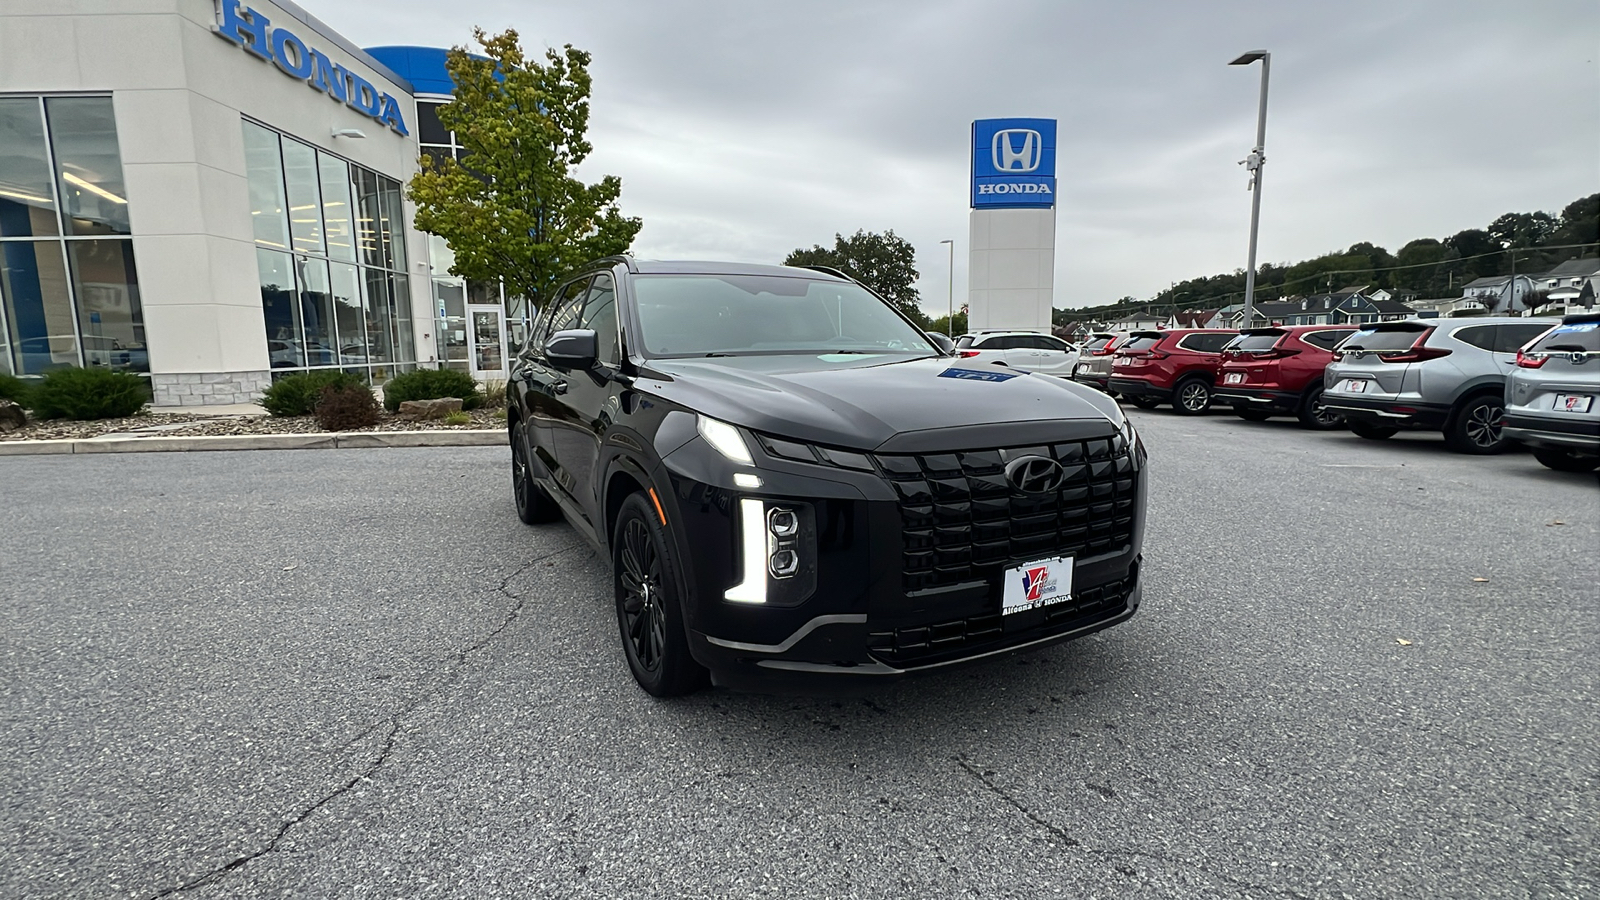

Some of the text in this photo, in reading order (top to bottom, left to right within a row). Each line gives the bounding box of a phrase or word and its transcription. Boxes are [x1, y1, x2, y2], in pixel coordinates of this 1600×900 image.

[211, 0, 409, 137] HONDA
[978, 183, 1052, 195] HONDA
[1002, 594, 1072, 616] Altoona HONDA
